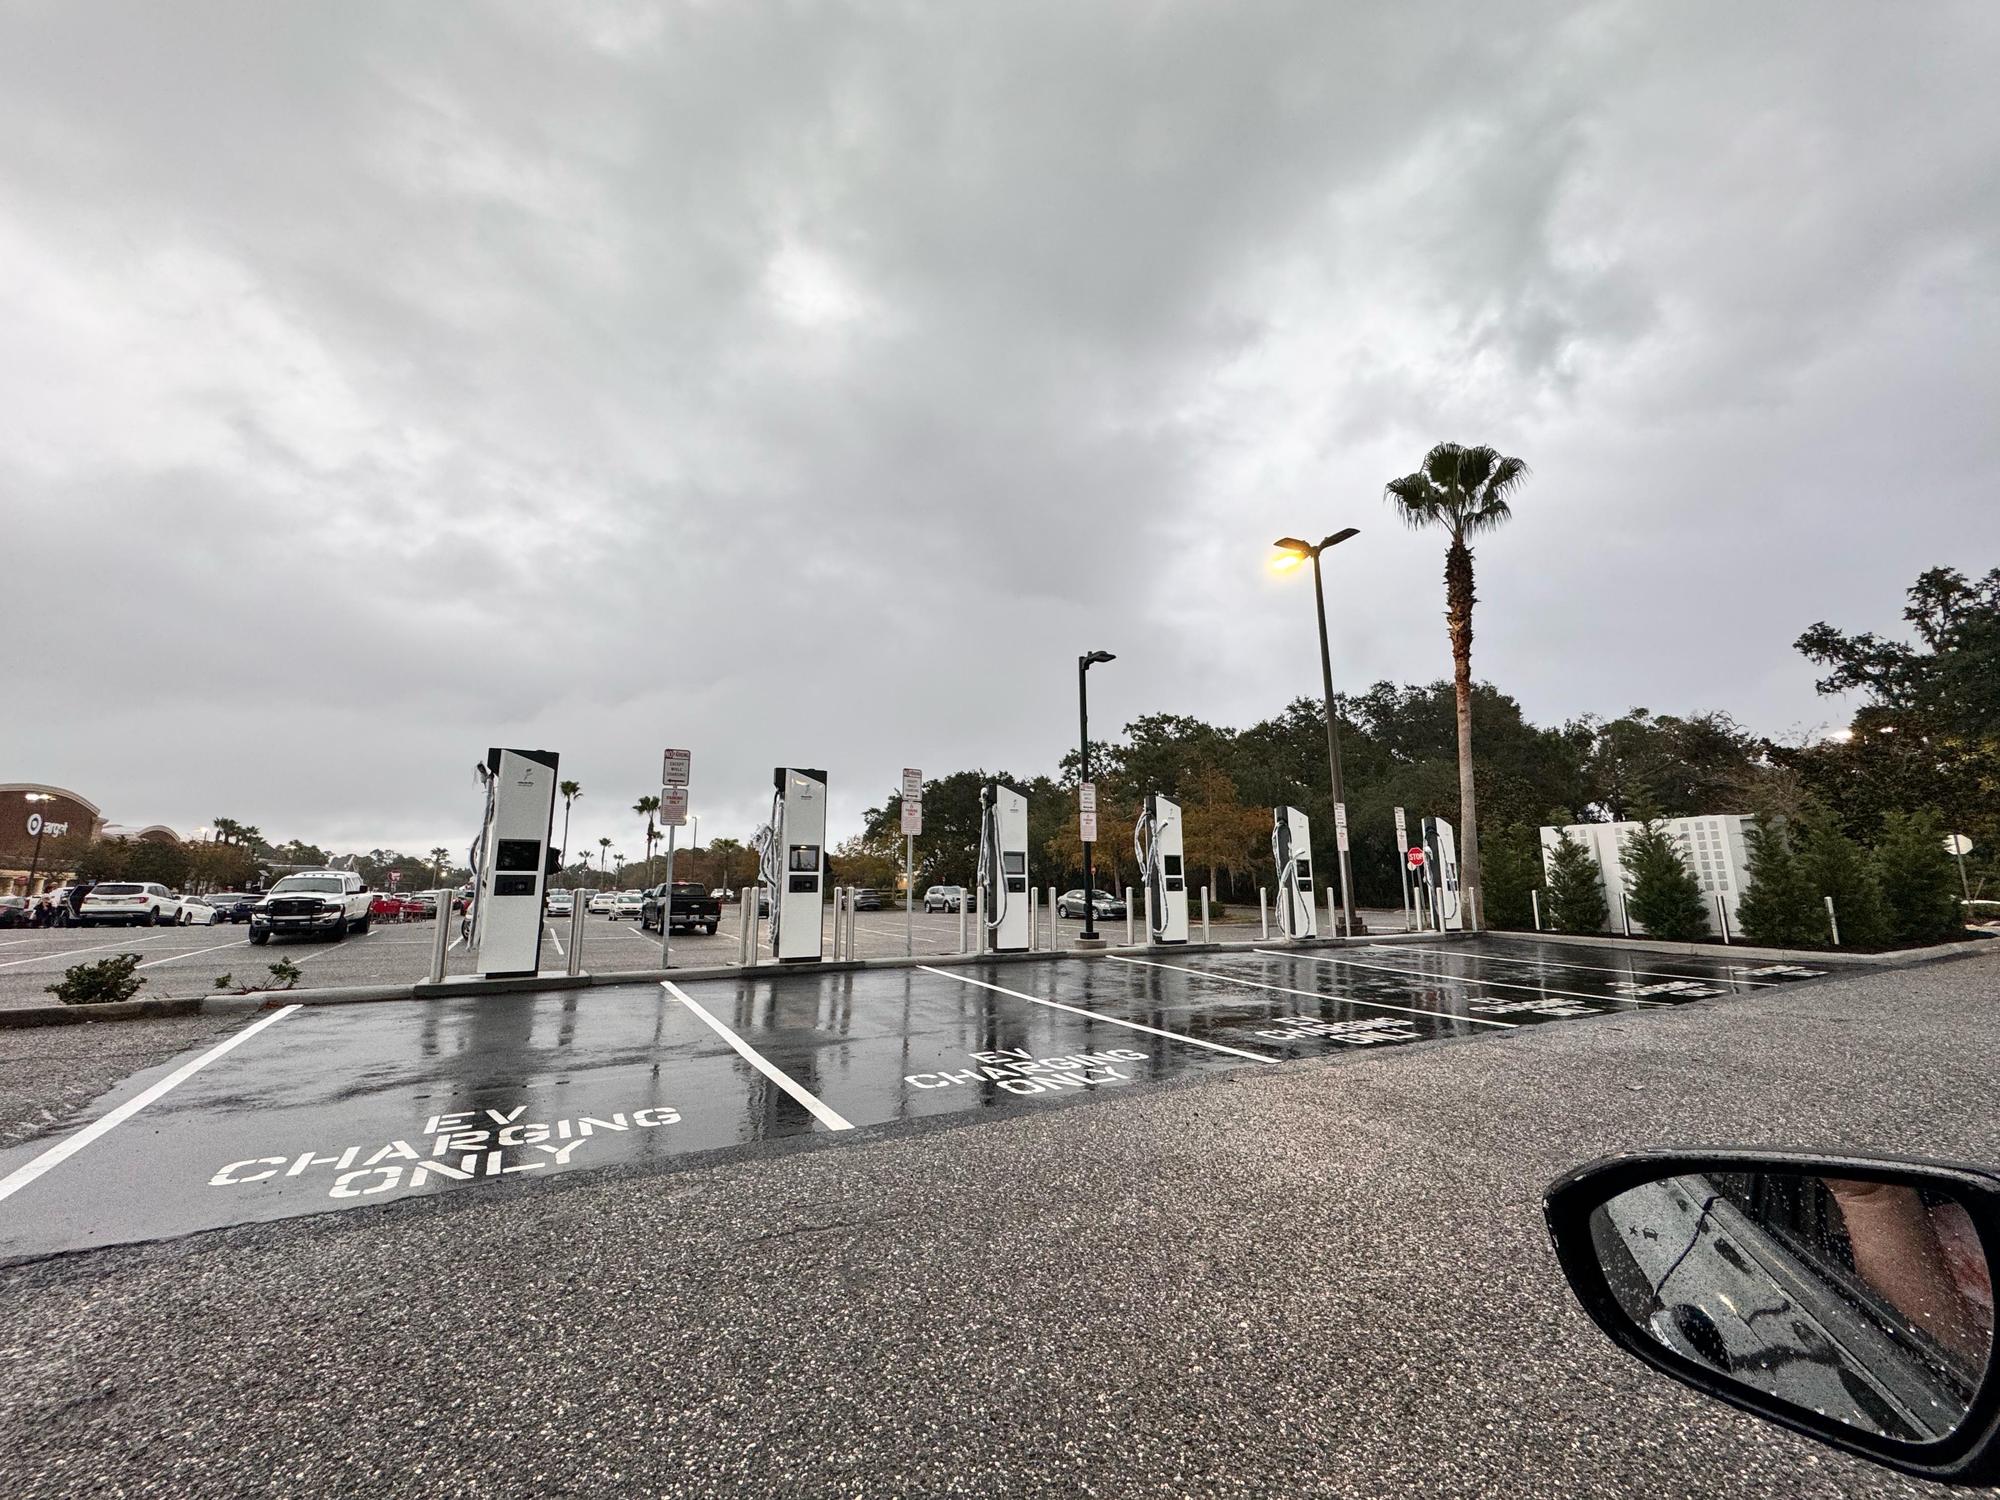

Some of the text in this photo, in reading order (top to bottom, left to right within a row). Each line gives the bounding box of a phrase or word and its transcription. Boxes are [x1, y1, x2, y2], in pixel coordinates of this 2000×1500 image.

[41, 821, 68, 838] arget
[903, 1049, 1149, 1089] CHARGING
[968, 1048, 1032, 1064] EV
[996, 1065, 1130, 1095] ONLY
[423, 1105, 528, 1135] EV
[207, 1107, 682, 1187] CHARGING
[328, 1138, 587, 1198] ONLY
